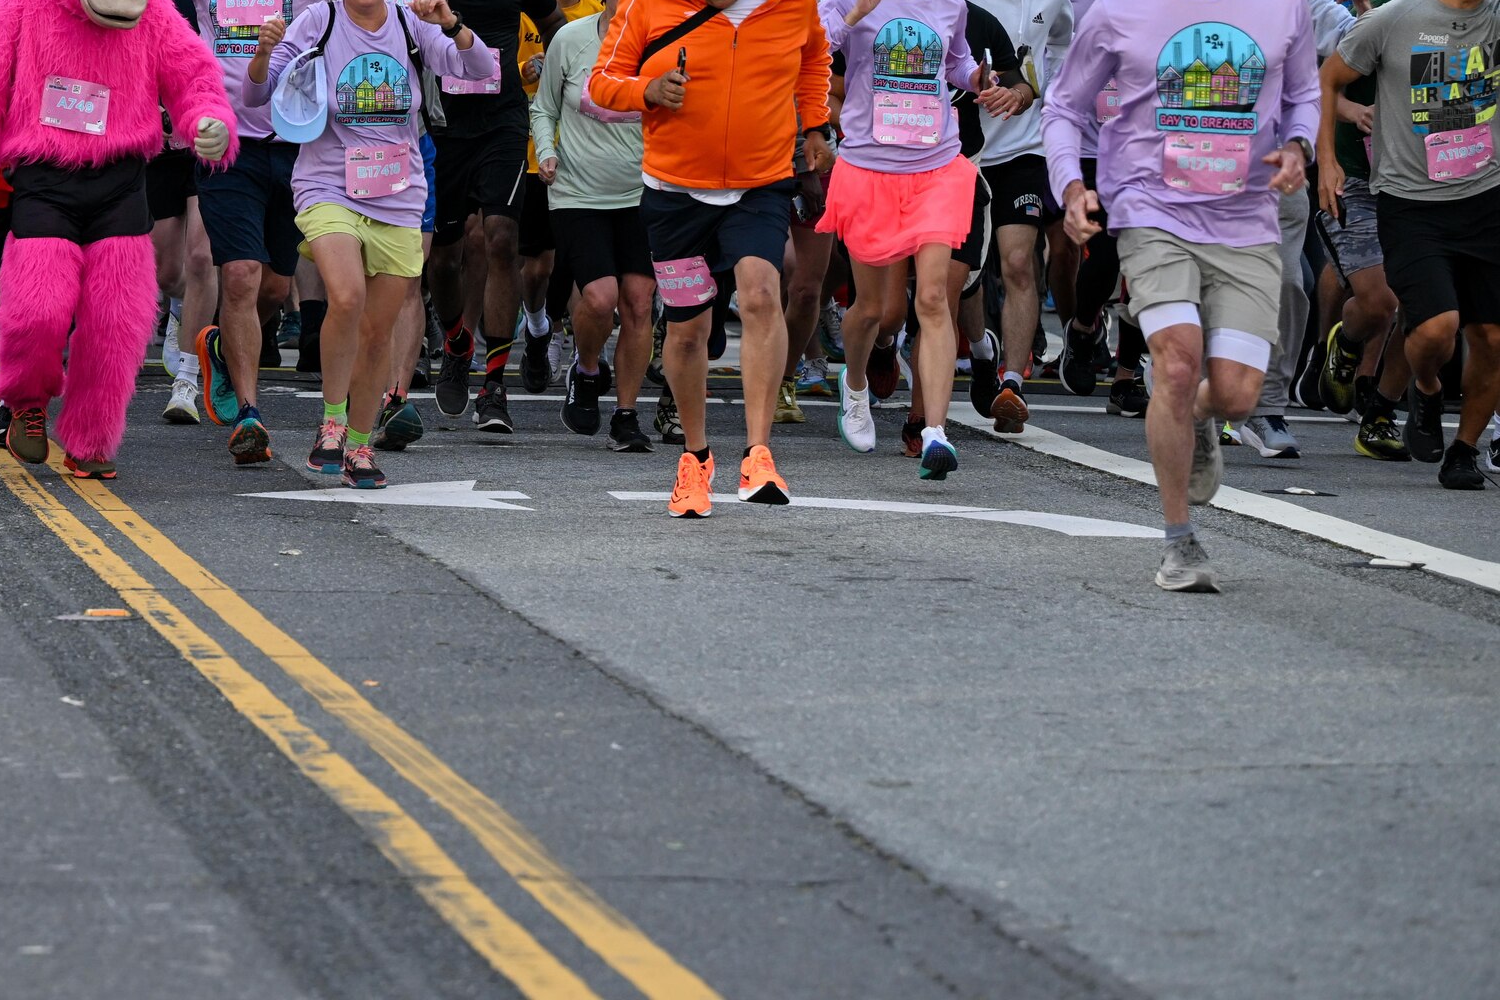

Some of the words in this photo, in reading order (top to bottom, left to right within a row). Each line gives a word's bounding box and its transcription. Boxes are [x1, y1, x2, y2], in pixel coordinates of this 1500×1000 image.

[1418, 32, 1445, 43] Zappos
[230, 44, 242, 53] TO
[889, 80, 898, 89] TO
[899, 81, 937, 92] BREAKERS
[56, 95, 95, 114] A749
[355, 116, 366, 124] TO
[882, 112, 934, 127] B17039
[1159, 114, 1182, 127] BAY
[1182, 115, 1199, 128] TO
[1201, 116, 1255, 130] BREAKERS
[1411, 112, 1429, 122] 12K
